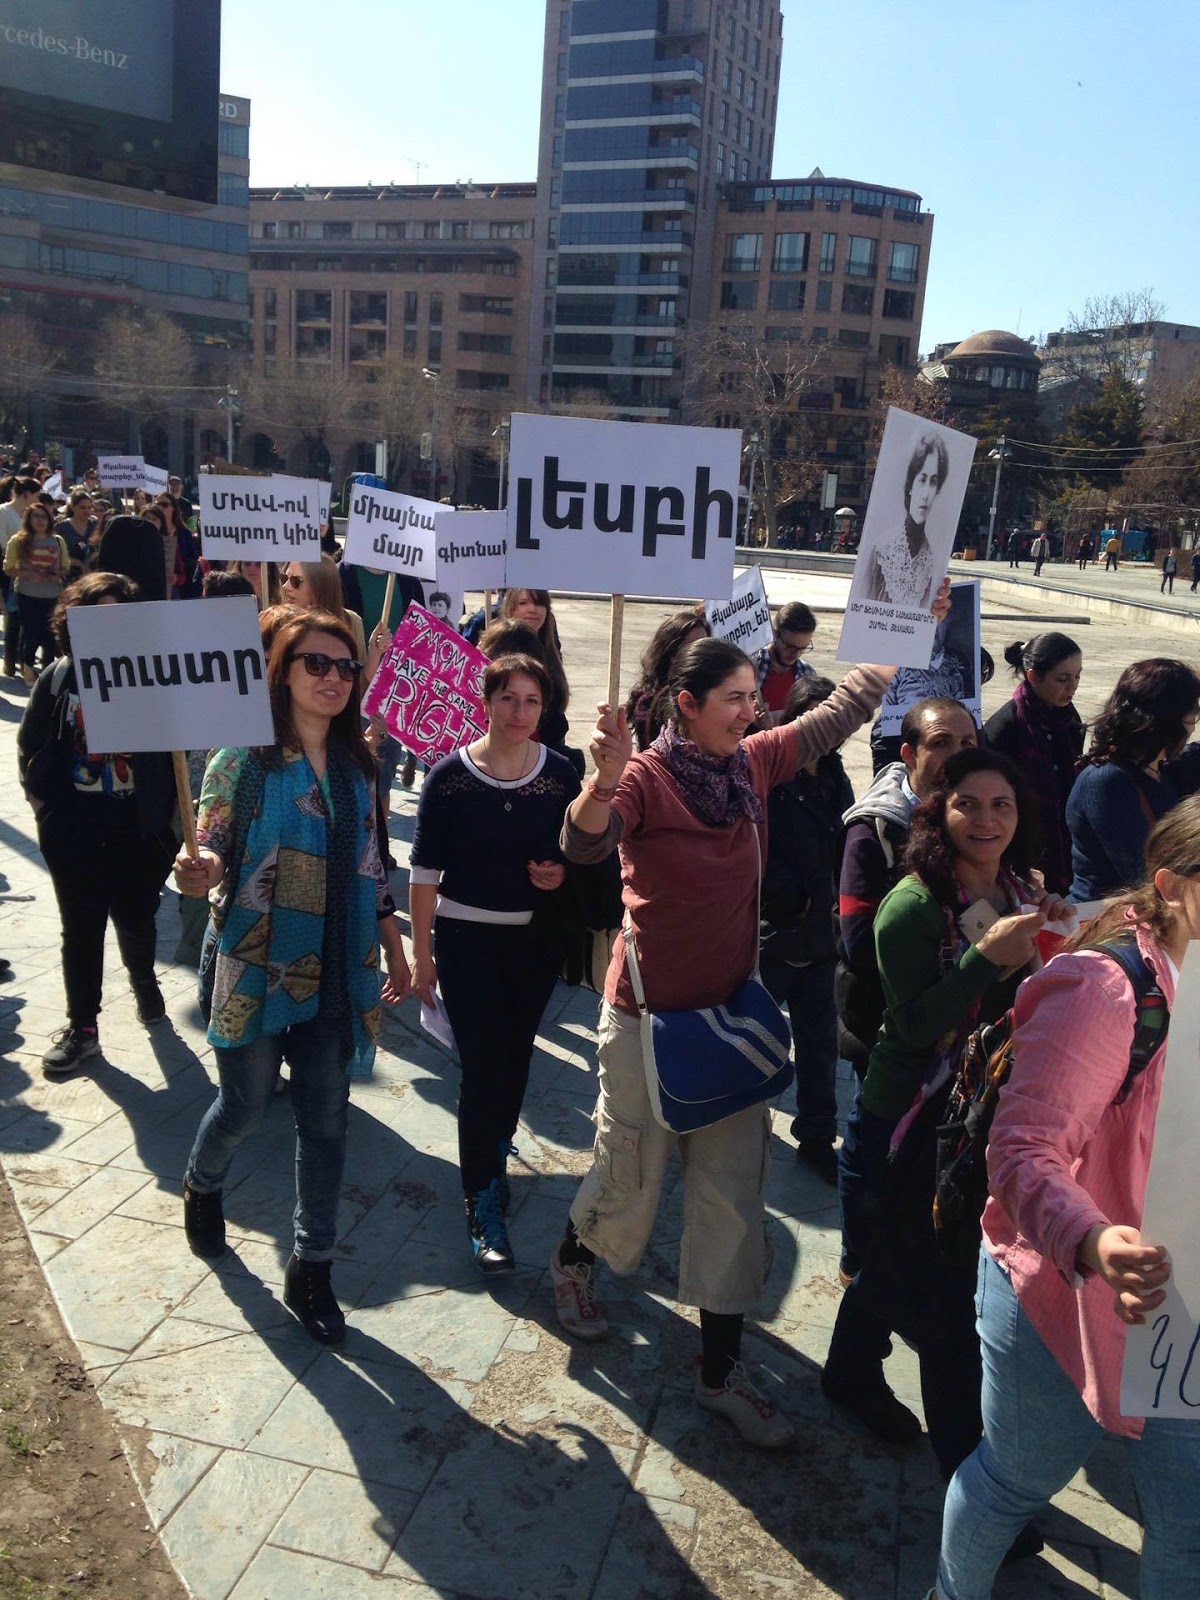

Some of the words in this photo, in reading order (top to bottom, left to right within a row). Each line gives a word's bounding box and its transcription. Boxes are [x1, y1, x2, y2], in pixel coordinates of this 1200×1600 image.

[0, 24, 128, 70] cedes-Benz
[212, 492, 310, 518] ՄԻԱՎ-ով
[354, 494, 435, 531] միայնա
[515, 455, 734, 560] լեսբի
[204, 525, 278, 545] ապրող
[283, 523, 318, 545] կին
[373, 533, 424, 566] մայր
[407, 611, 428, 628] MY
[80, 648, 263, 702] դուստր
[385, 647, 430, 684] HAVE
[433, 679, 448, 697] THE
[448, 691, 475, 716] SAME
